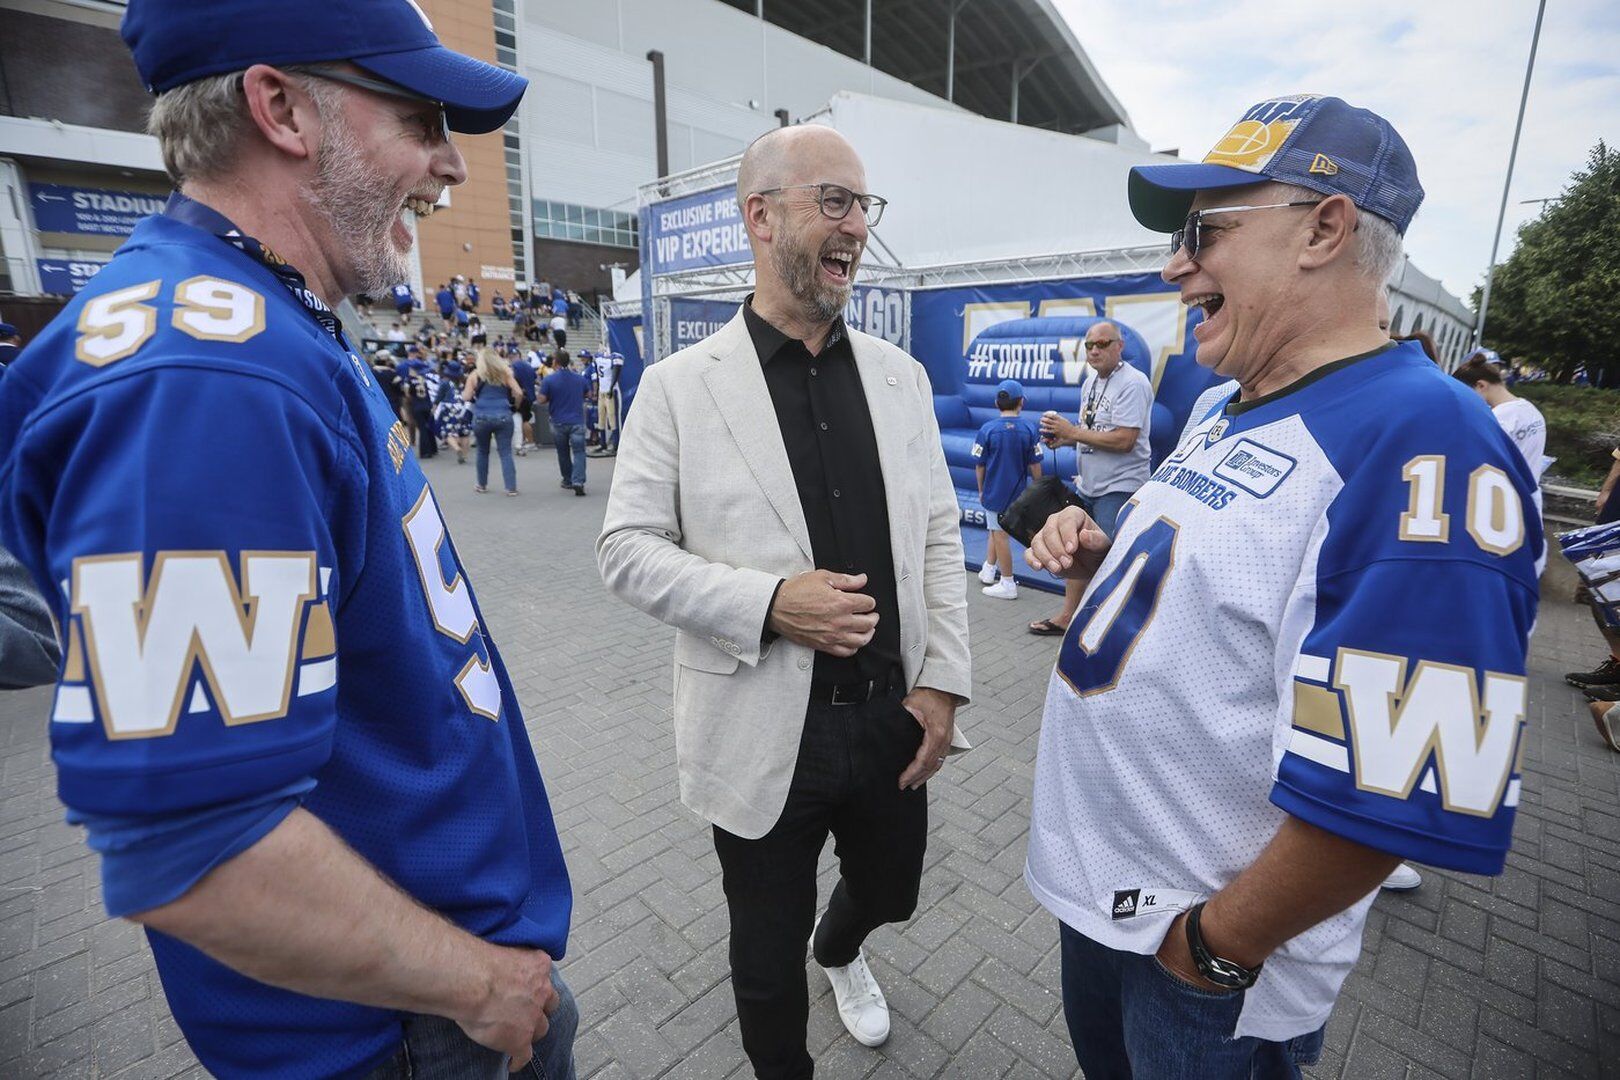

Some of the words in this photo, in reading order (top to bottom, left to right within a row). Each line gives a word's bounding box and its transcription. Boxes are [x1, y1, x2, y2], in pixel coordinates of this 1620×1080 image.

[660, 203, 713, 232] EXCLUSIVE
[656, 235, 680, 264] VIP
[682, 223, 752, 260] EXPERIE
[75, 274, 266, 367] 59
[677, 320, 725, 340] EXCLU
[865, 289, 903, 345] GO
[968, 343, 1057, 380] #FORTHE
[1239, 462, 1265, 479] Group
[1247, 456, 1282, 478] Investors
[1169, 466, 1238, 511] BOMBERS
[1398, 454, 1526, 557] 10
[70, 549, 318, 742] W
[1332, 646, 1529, 819] W
[1141, 894, 1157, 907] XL
